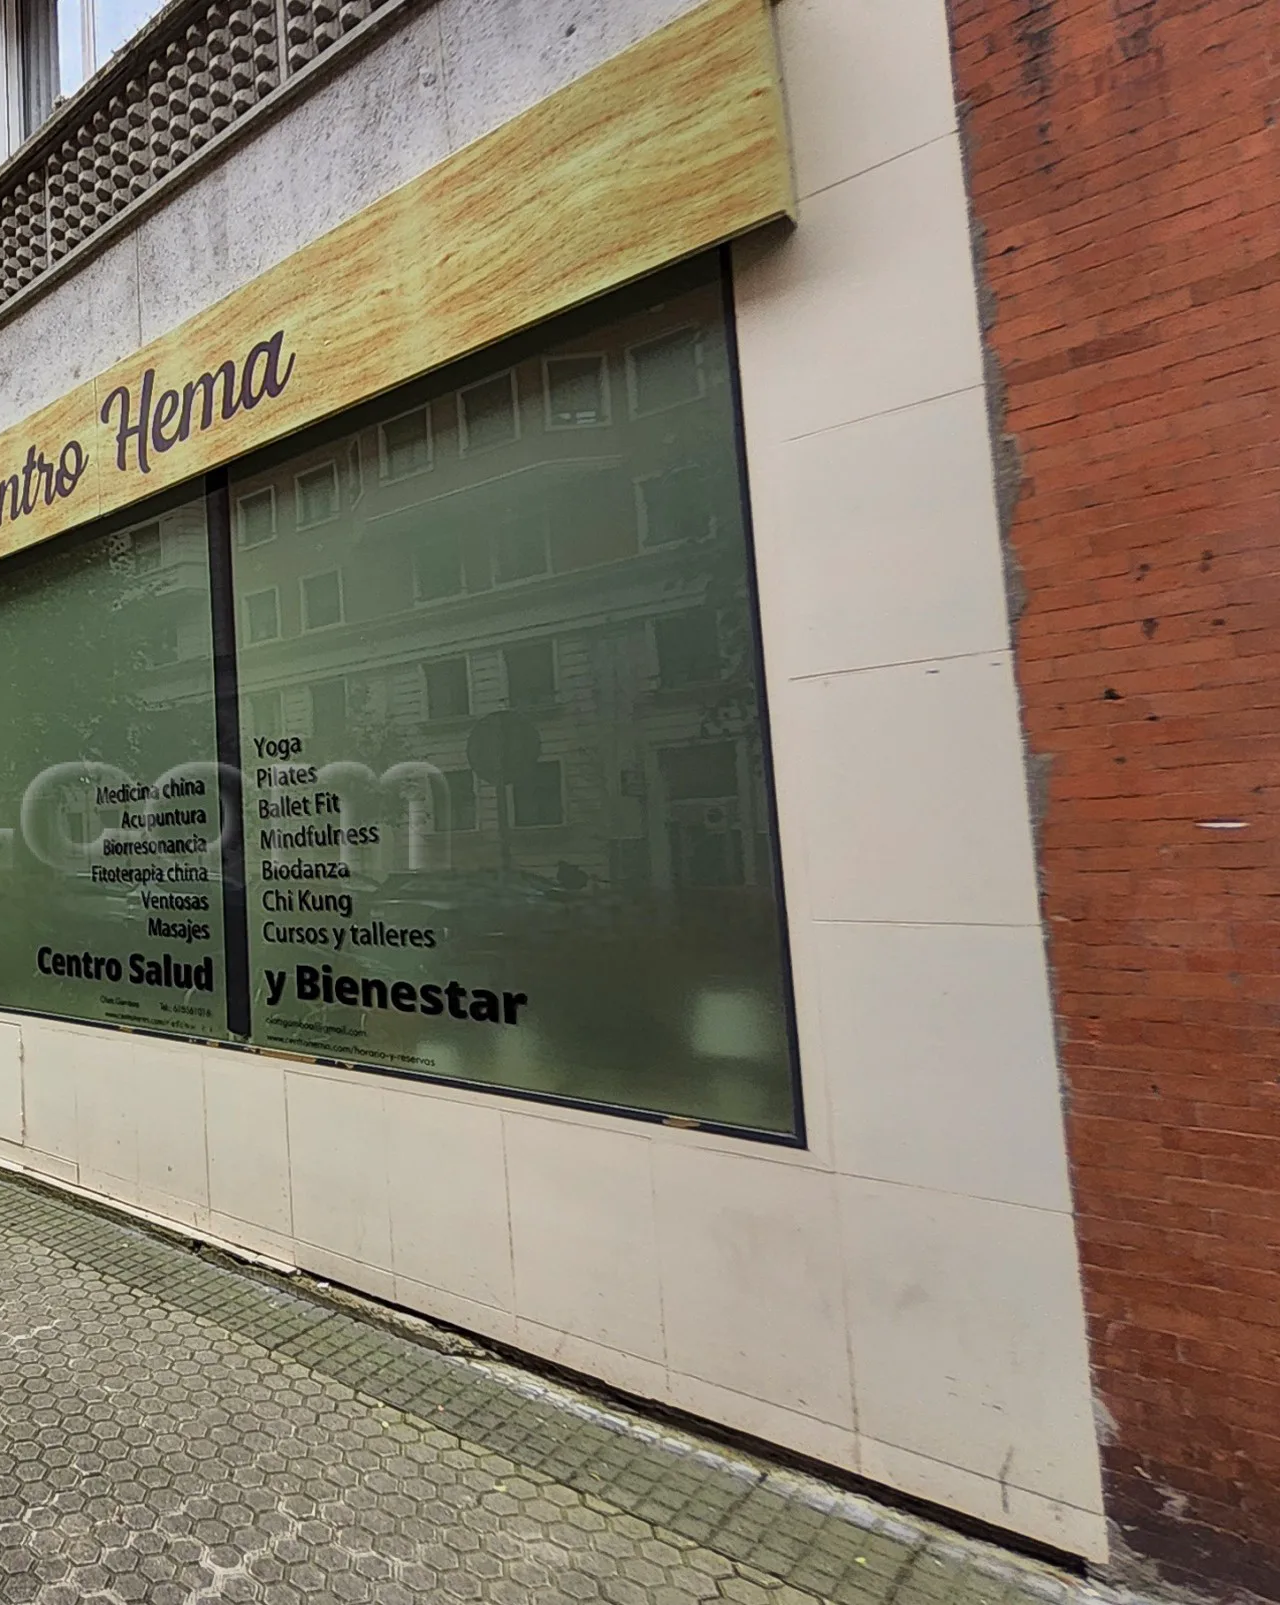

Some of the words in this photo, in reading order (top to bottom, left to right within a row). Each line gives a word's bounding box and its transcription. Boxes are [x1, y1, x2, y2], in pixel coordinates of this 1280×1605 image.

[100, 330, 296, 474] Hema
[254, 736, 302, 760] Yoga
[256, 764, 318, 789] Pilates
[95, 782, 159, 806] Medicina
[162, 779, 206, 798] china
[258, 795, 312, 820] Ballet
[314, 792, 341, 815] Fit
[121, 809, 207, 831] Acupuntura
[103, 832, 208, 856] Biorresonancia
[260, 823, 380, 850] Mindfulness
[91, 864, 164, 886] Fitoterapia
[166, 862, 209, 883] china
[261, 860, 350, 881] Biodanza
[141, 891, 210, 911] Ventosas
[261, 889, 293, 912] Chi
[298, 889, 353, 917] Kung
[148, 918, 210, 943] Masajes
[263, 921, 328, 945] Cursos
[333, 926, 350, 950] y
[349, 921, 437, 948] talleres
[36, 946, 122, 982] Centro
[129, 953, 215, 992] Salud
[264, 968, 287, 1006] y
[296, 964, 528, 1025] Bienestar
